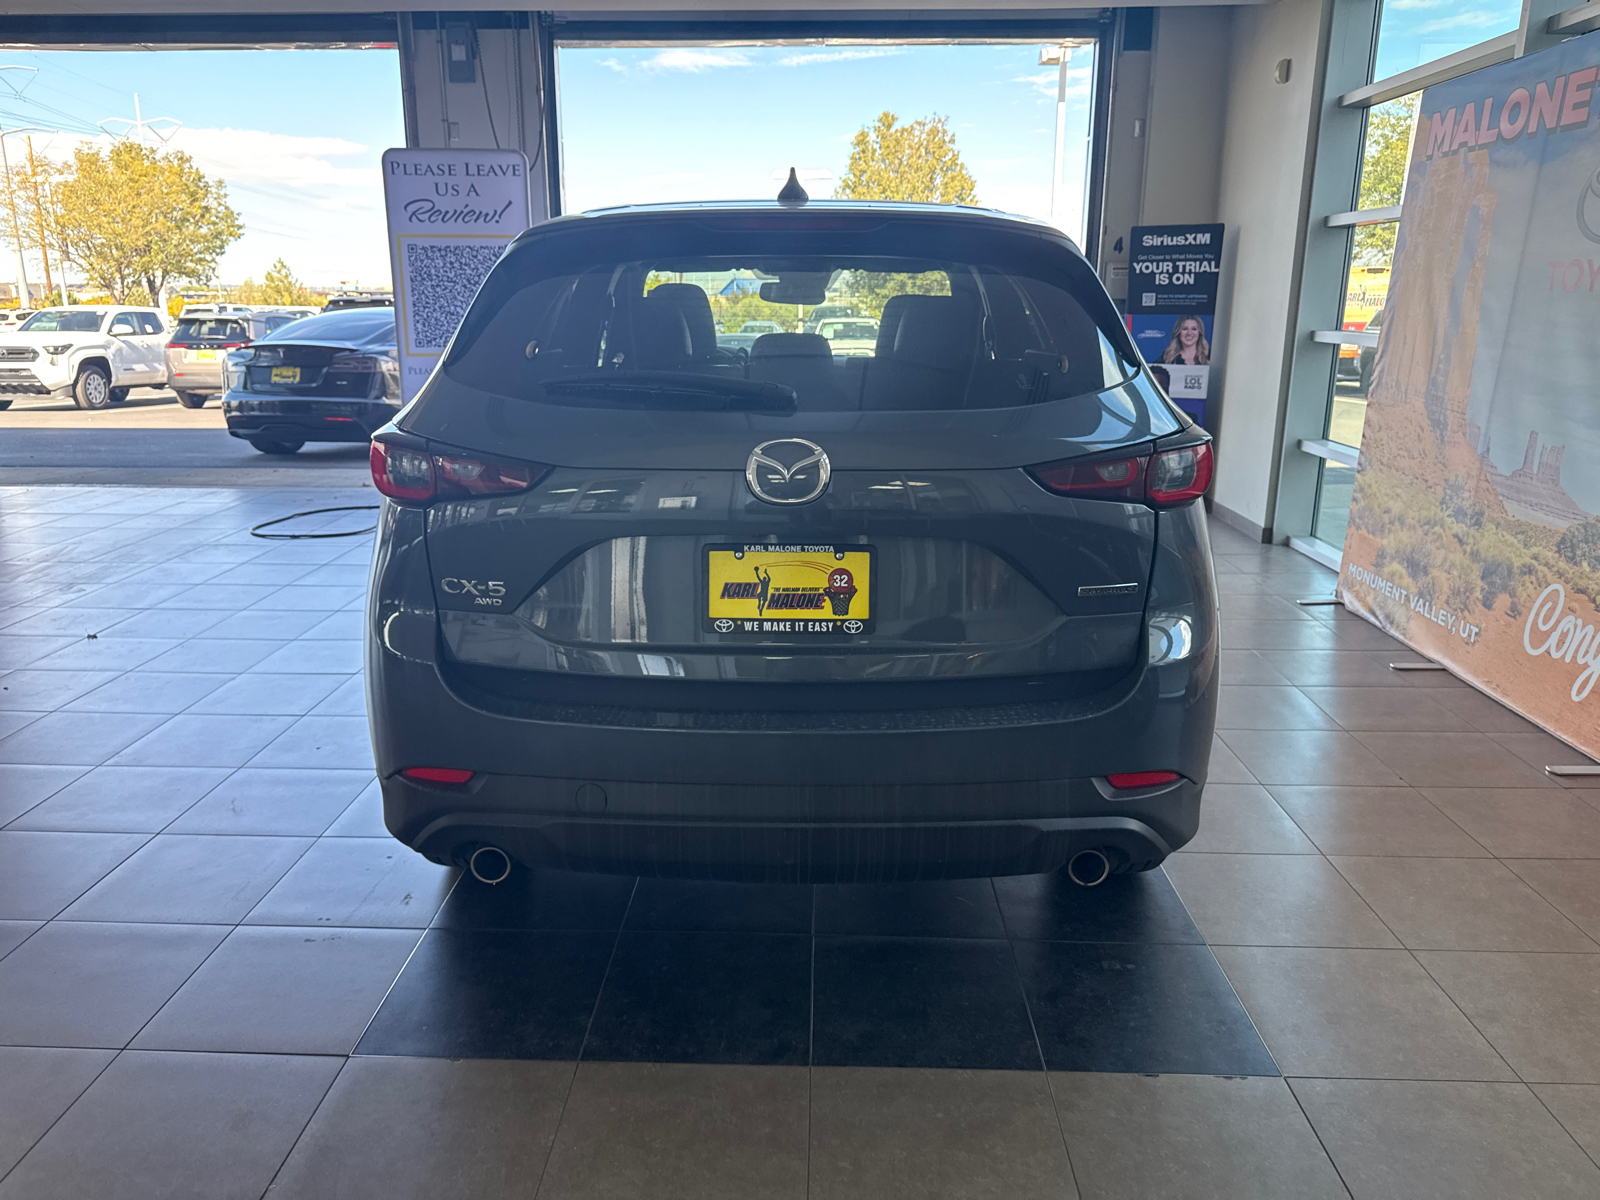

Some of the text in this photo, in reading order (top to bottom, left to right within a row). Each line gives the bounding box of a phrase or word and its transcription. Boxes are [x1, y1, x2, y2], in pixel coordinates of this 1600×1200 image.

[1425, 66, 1597, 160] MALONE
[466, 183, 480, 197] A
[403, 198, 513, 224] Review!
[1113, 236, 1123, 254] 4
[1142, 233, 1211, 247] SiriusXM
[1133, 260, 1219, 274] YOUR TRIAL
[1155, 273, 1194, 285] IS ON
[1346, 292, 1363, 303] ARL
[1184, 377, 1202, 385] LOL
[803, 545, 835, 553] TOYOTA
[441, 577, 506, 596] CX-5
[833, 575, 849, 587] 32
[720, 582, 760, 599] KARL
[474, 597, 502, 606] AWD
[766, 593, 826, 610] MALONE
[1347, 563, 1479, 643] MONUMENT VALLEY, UT
[743, 621, 834, 632] WE MAKE IT EASY
